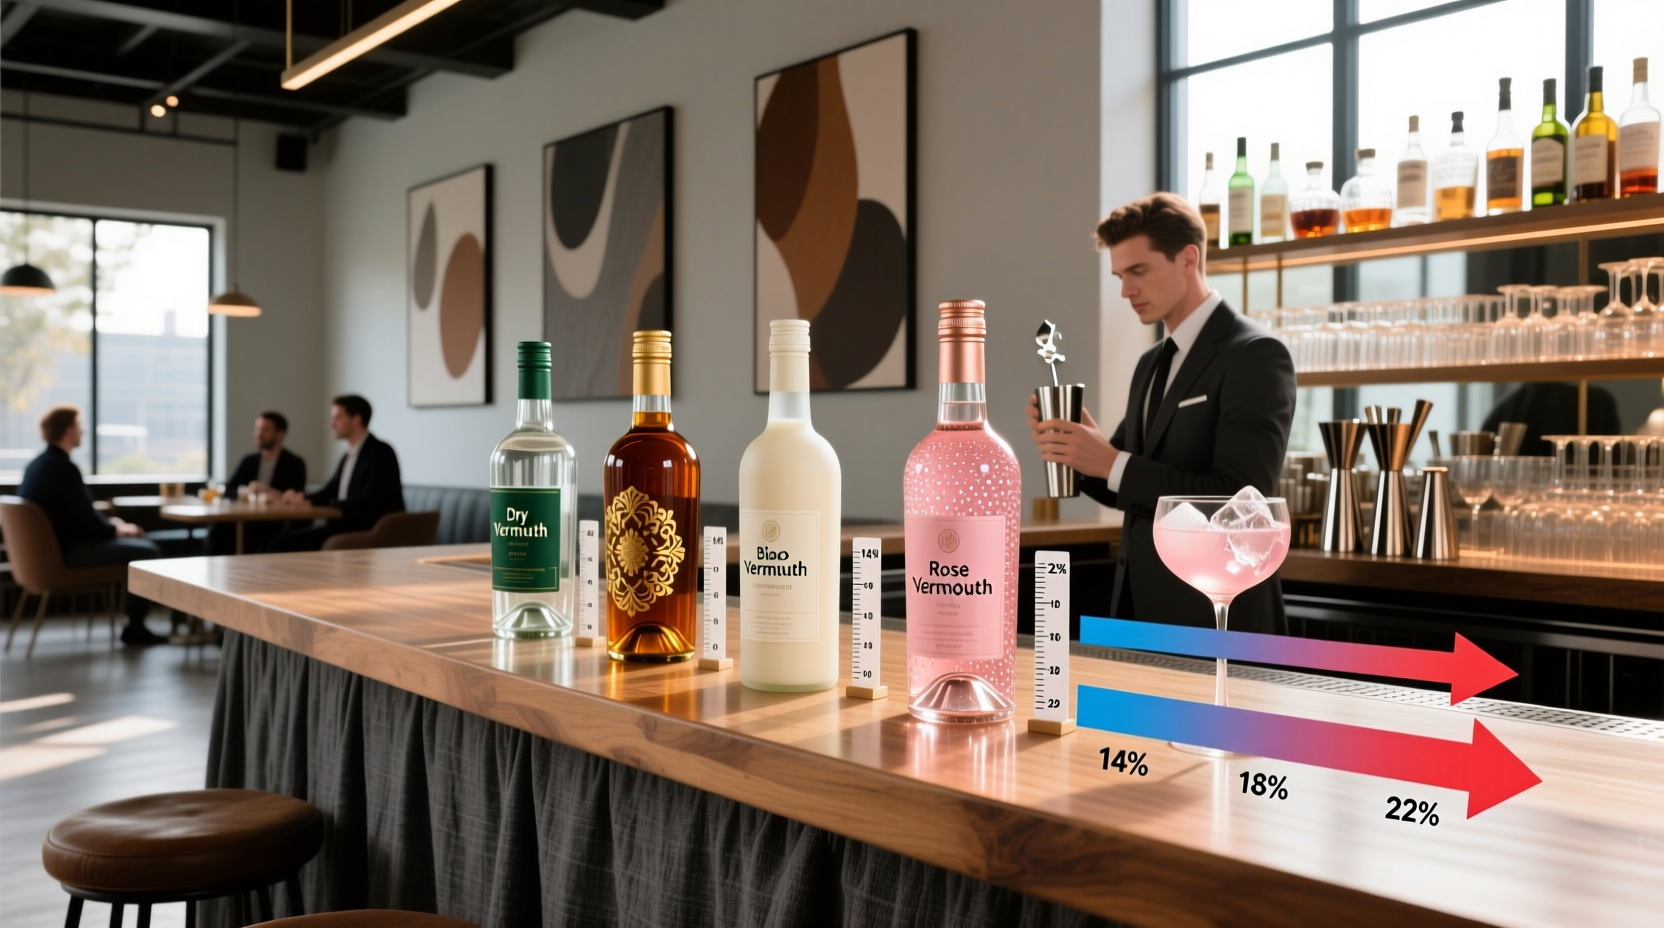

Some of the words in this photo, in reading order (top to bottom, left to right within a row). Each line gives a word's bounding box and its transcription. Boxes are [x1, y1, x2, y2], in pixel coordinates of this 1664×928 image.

[507, 507, 529, 526] Dry
[929, 560, 969, 578] Rose
[912, 576, 993, 596] Vermouth
